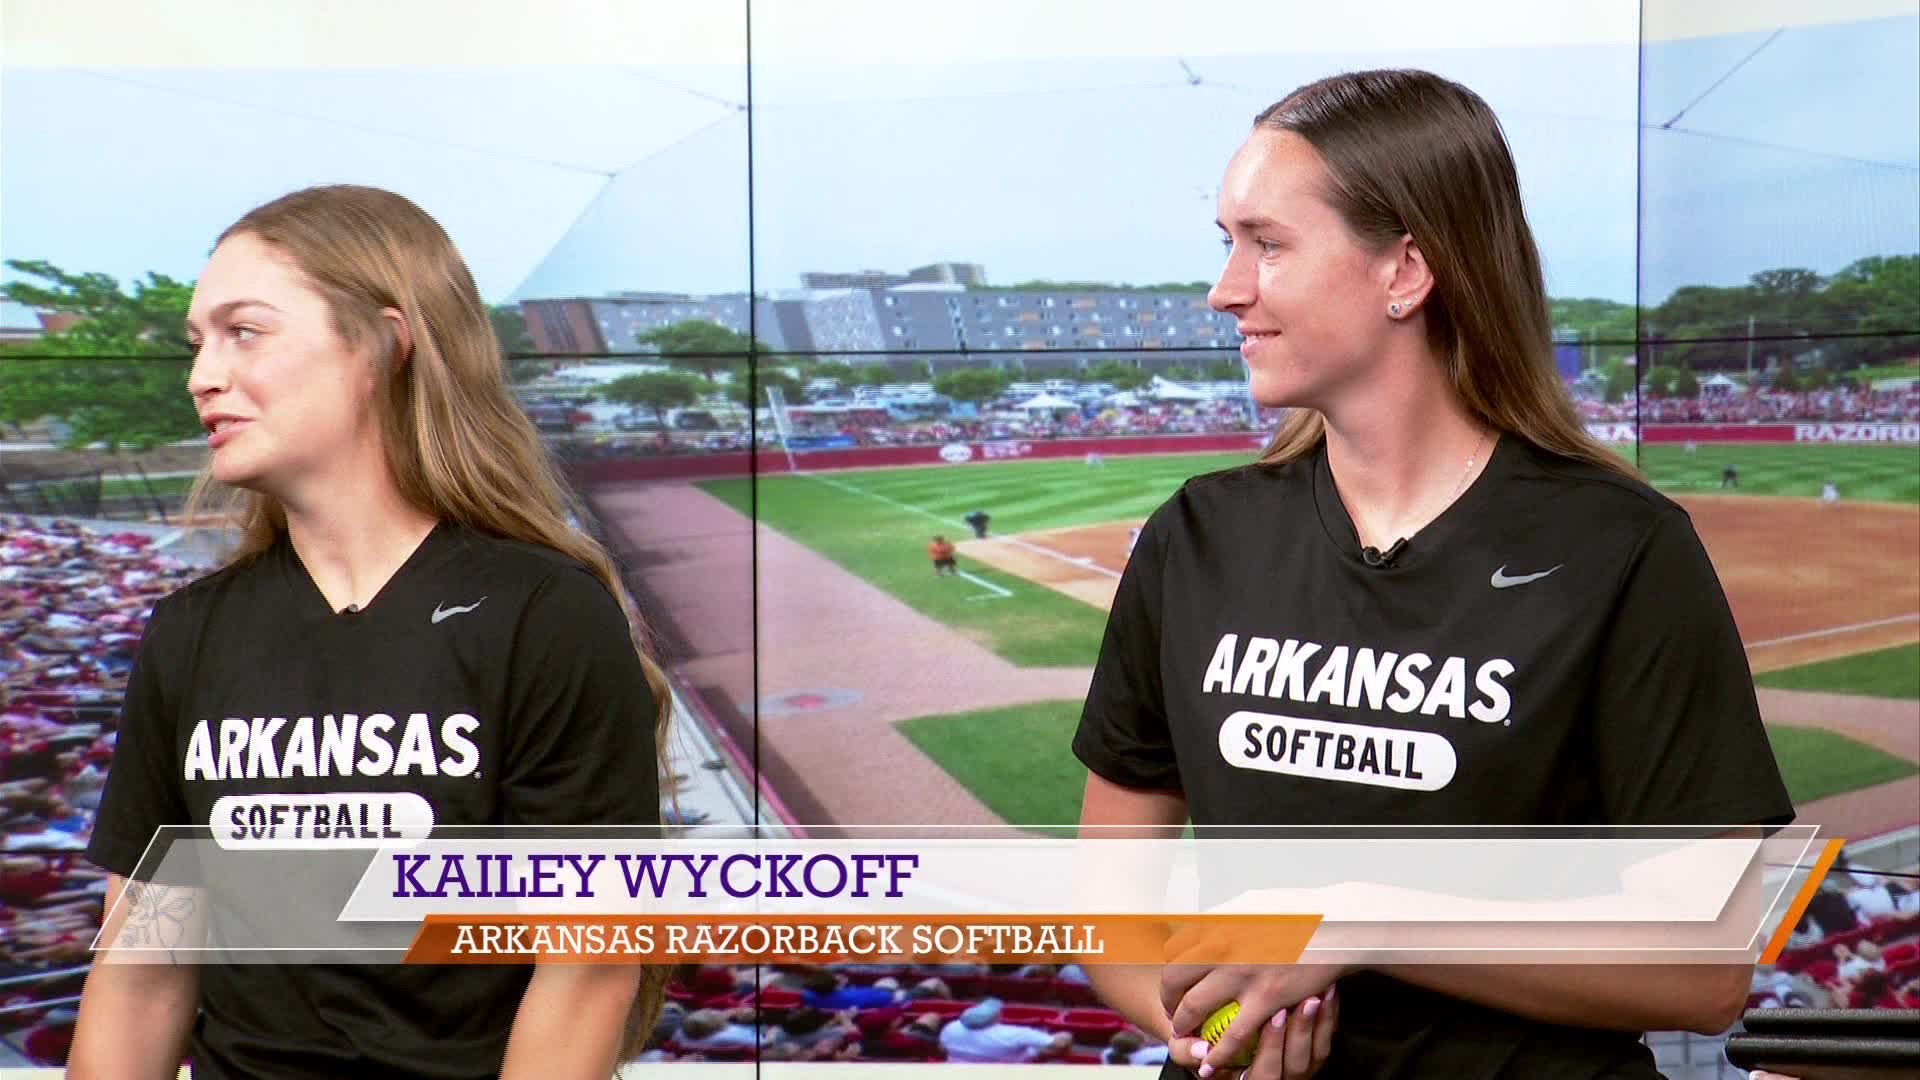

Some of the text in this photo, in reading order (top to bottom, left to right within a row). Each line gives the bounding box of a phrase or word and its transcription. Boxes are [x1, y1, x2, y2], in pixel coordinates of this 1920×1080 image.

[1202, 633, 1516, 725] ARKANSAS
[184, 713, 481, 780] ARKANSAS
[1244, 722, 1424, 780] SOFTBALL
[230, 802, 403, 840] SOFTBALL
